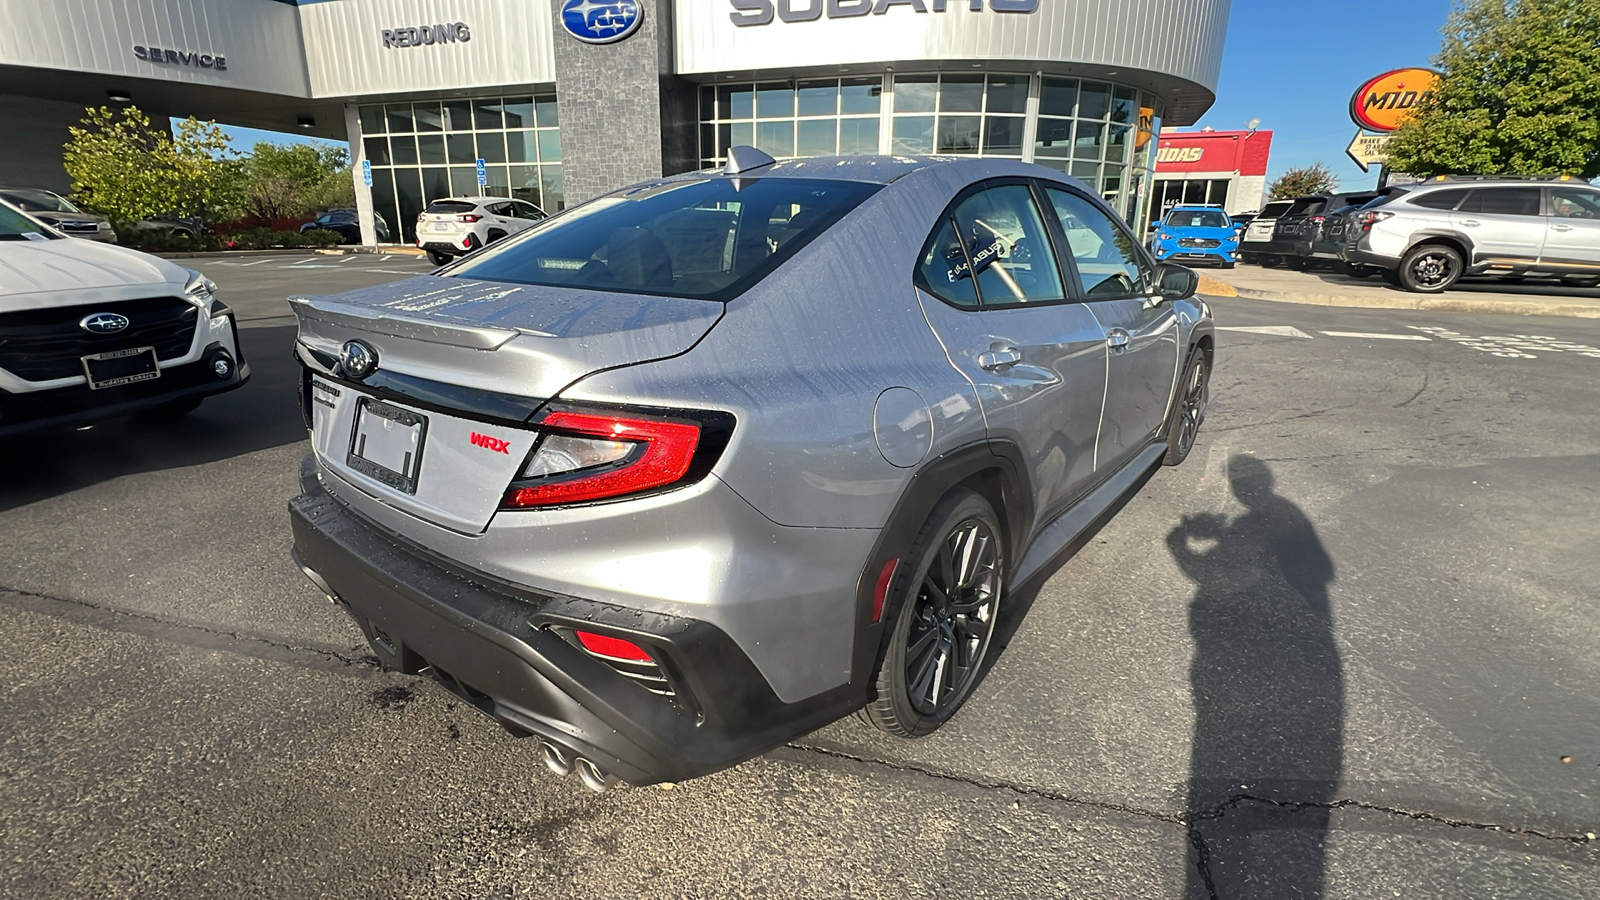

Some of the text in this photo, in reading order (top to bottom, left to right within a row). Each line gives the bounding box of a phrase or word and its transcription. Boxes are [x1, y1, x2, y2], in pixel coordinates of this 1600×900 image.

[381, 22, 470, 49] REDDING
[134, 45, 227, 71] SERVICE
[1364, 91, 1434, 112] MIDA
[470, 431, 511, 455] WRX
